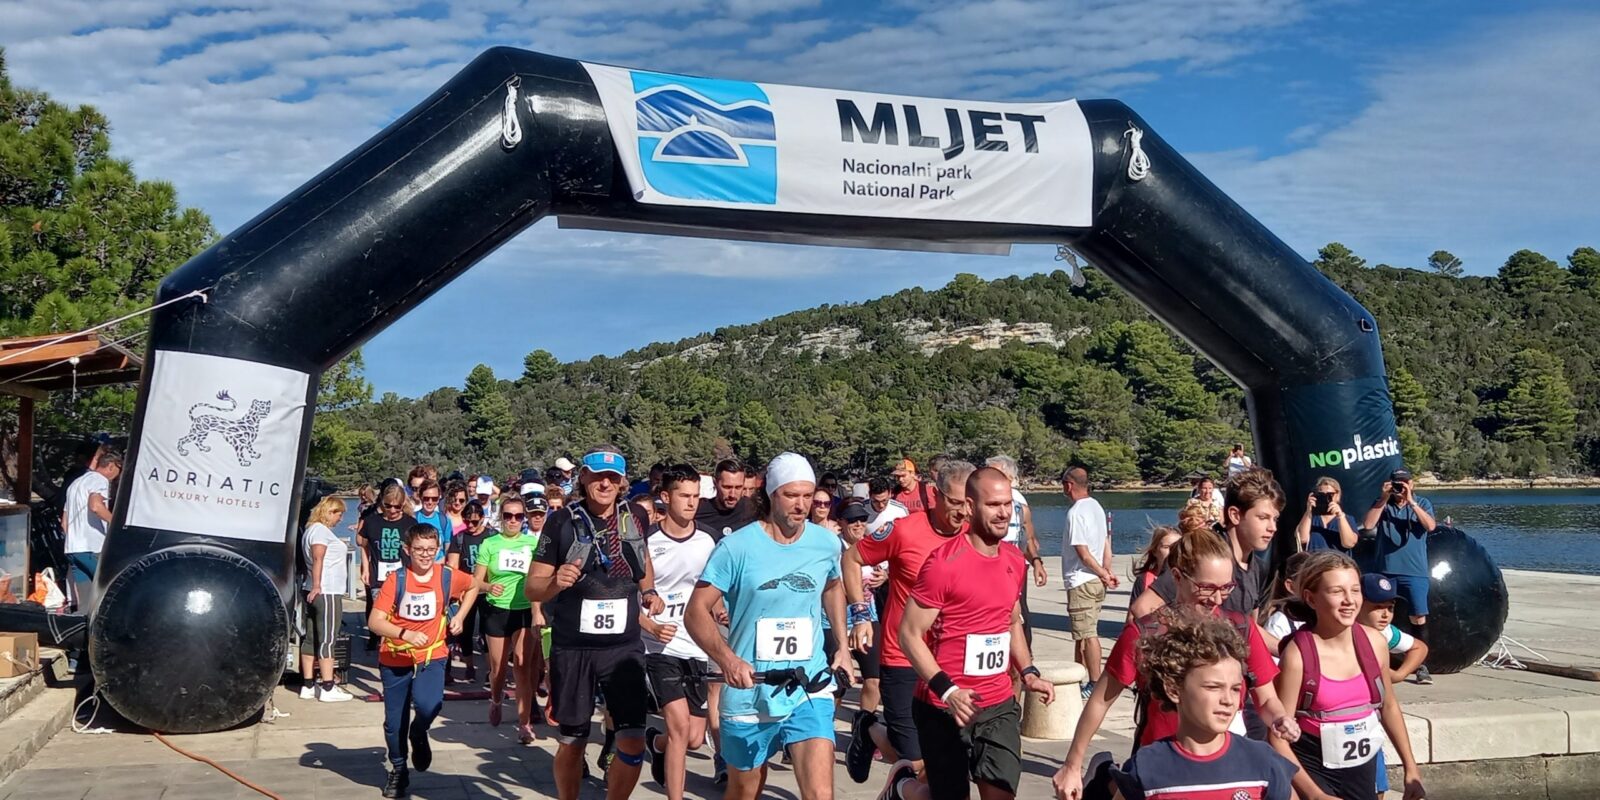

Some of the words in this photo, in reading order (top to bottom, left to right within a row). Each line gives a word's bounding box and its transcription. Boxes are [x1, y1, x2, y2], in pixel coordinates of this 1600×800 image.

[835, 98, 1046, 161] MLJET
[842, 158, 932, 178] Nacionalni
[936, 164, 972, 182] park
[843, 180, 915, 199] National
[919, 185, 956, 201] Park
[148, 467, 280, 496] ADRIATIC
[163, 490, 208, 502] LUXURY
[216, 498, 261, 509] HOTELS
[381, 527, 401, 539] RA
[380, 538, 401, 549] NG
[381, 548, 400, 560] ER
[504, 558, 525, 570] 122
[405, 603, 430, 617] 133
[667, 603, 685, 618] 77
[593, 614, 615, 630] 85
[773, 636, 798, 656] 76
[976, 650, 1004, 670] 103
[1343, 738, 1370, 761] 26
